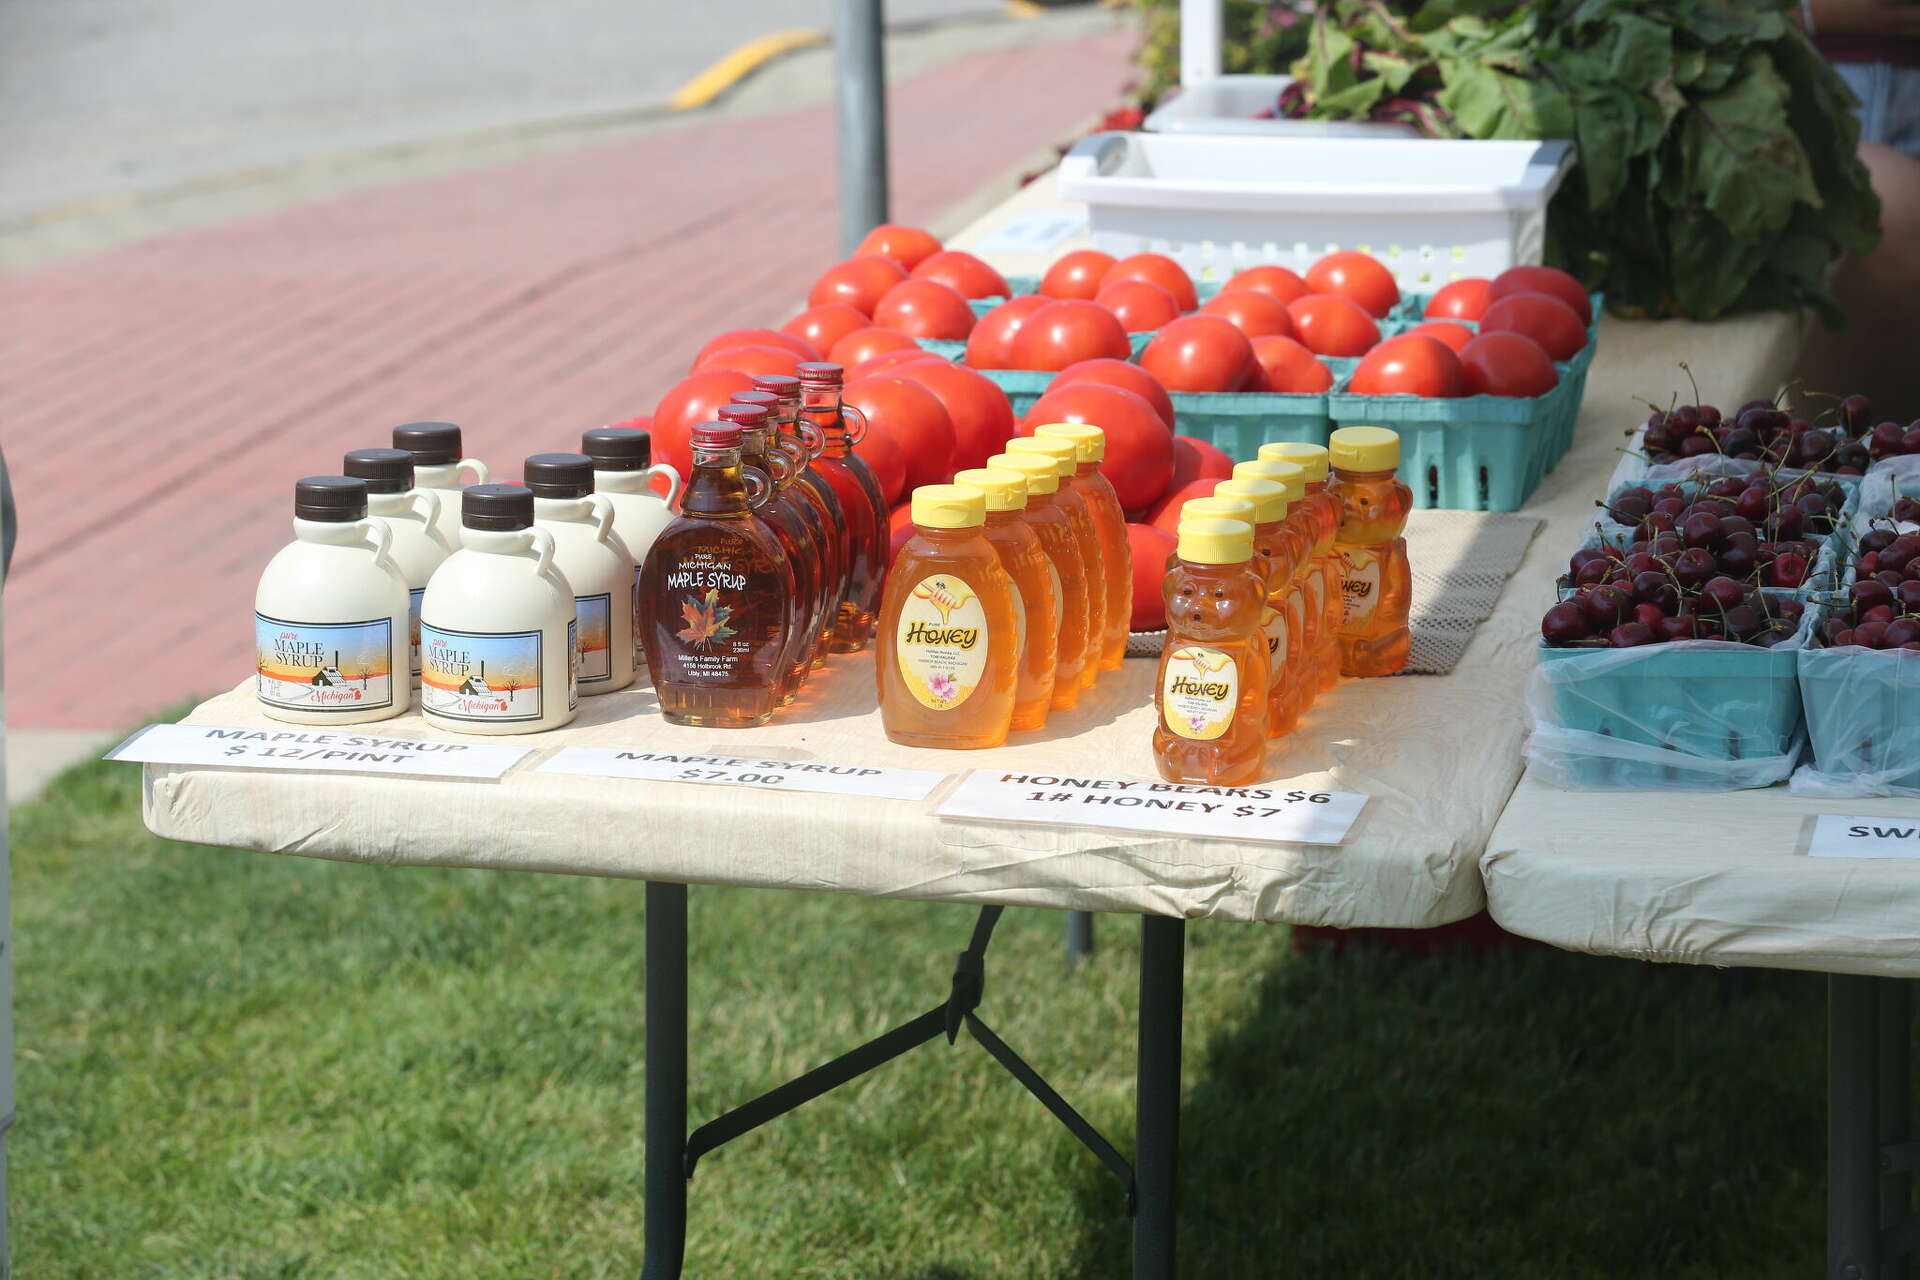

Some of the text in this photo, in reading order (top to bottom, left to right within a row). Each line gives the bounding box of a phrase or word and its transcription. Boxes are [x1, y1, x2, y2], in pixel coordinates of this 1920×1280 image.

[678, 561, 732, 571] MICHIGAN
[667, 571, 747, 591] MAPLE SYRUP
[1341, 580, 1372, 597] NEY
[274, 639, 325, 655] MAPLE
[428, 645, 472, 664] MAPLE
[275, 653, 324, 668] SYRUP
[700, 655, 721, 663] Family
[429, 661, 470, 677] SYRUP
[310, 690, 354, 705] Michigan
[457, 699, 500, 713] Michigan
[205, 728, 469, 753] MAPLE SYRUP
[224, 744, 415, 764] $ 12/PINT
[615, 751, 883, 777] MAPLE SYRUP
[680, 769, 786, 785] $7.00
[999, 774, 1332, 804] HONEY BEARS $6
[1026, 791, 1283, 818] 1# HONEY $7
[1848, 825, 1920, 839] SW
